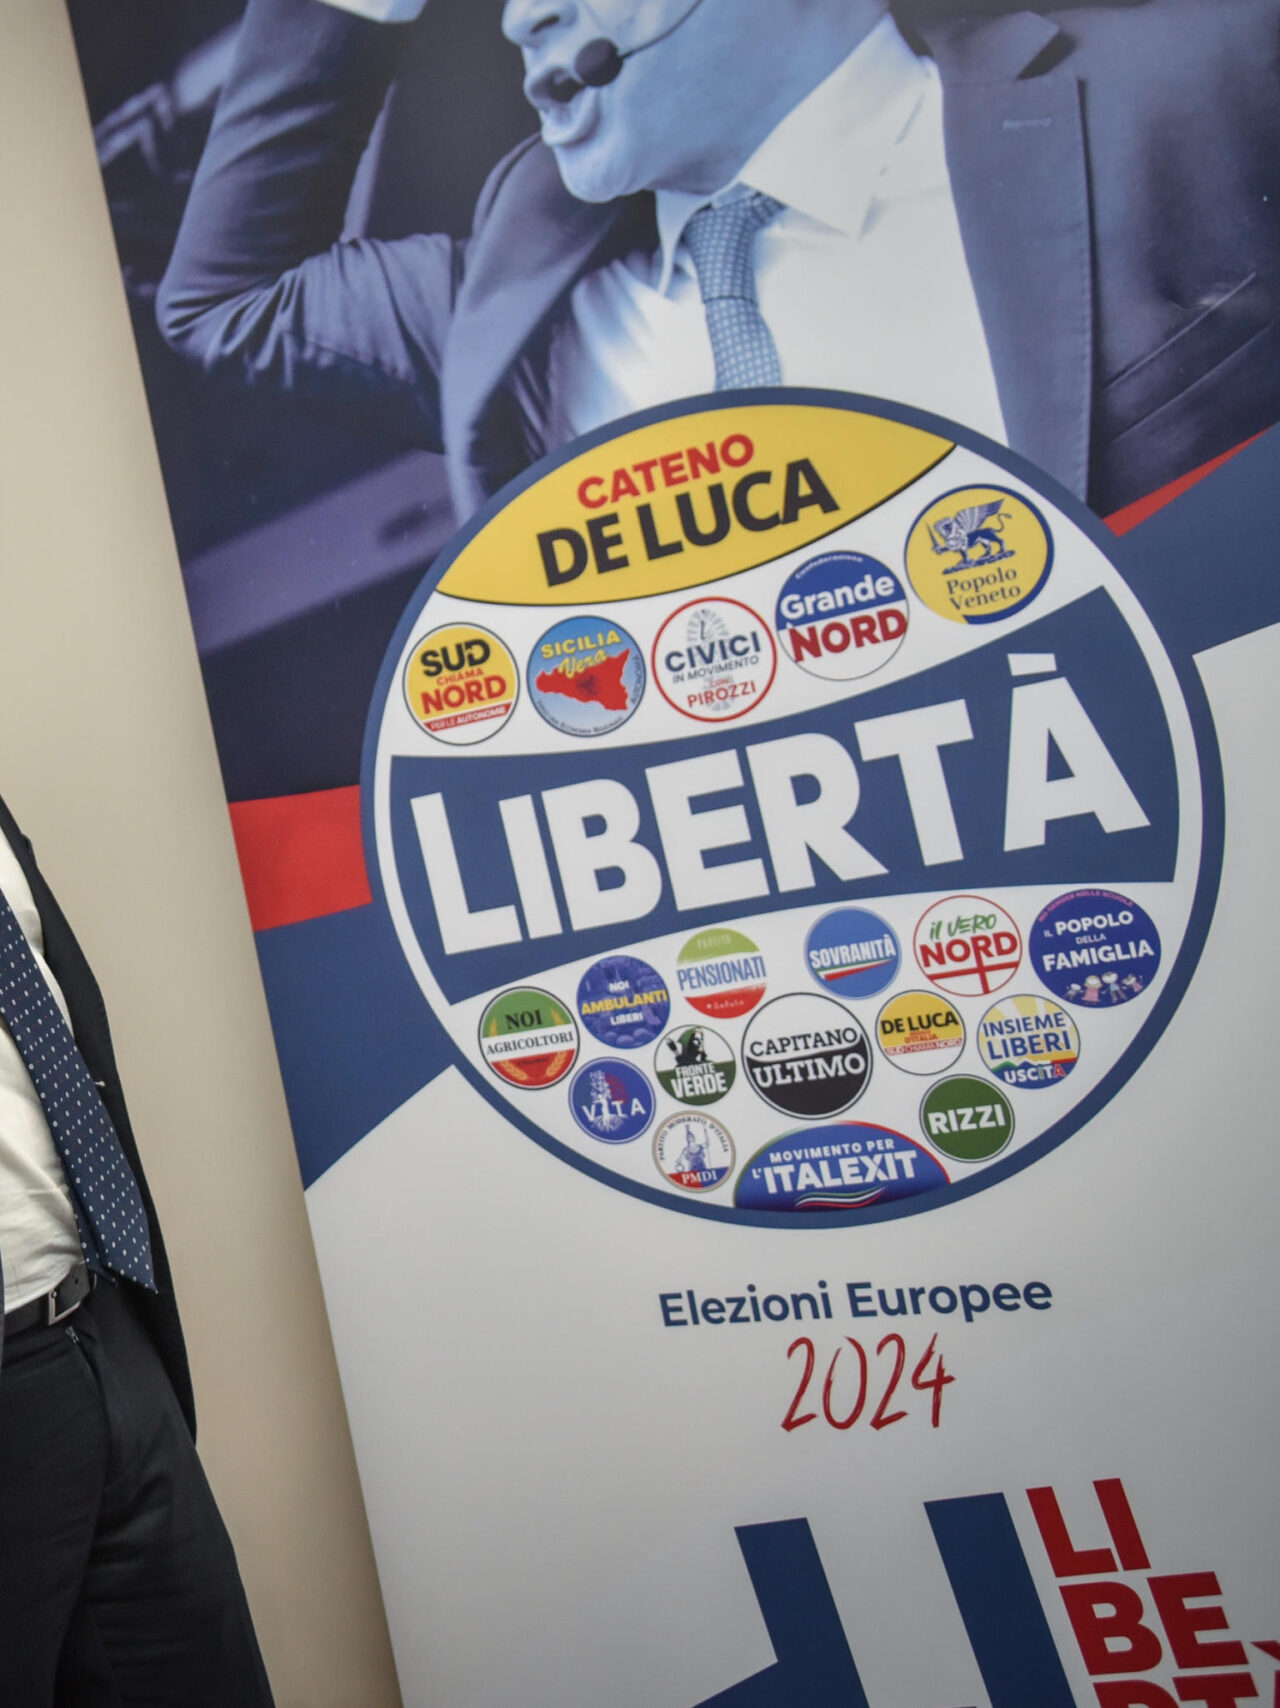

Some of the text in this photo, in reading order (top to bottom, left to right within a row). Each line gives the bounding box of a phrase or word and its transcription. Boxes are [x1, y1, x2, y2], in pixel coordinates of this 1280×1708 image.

[577, 433, 755, 509] CATENO
[536, 458, 840, 587] DE LUCA
[946, 567, 1017, 595] Popolo
[780, 574, 895, 620] Grande
[949, 585, 1022, 611] Veneto
[541, 629, 622, 660] SICILIA
[789, 608, 907, 663] NORD
[420, 638, 491, 678] SUD
[558, 648, 608, 678] Vera
[665, 631, 761, 672] CIVICI
[436, 667, 484, 687] CHIAMA
[672, 655, 759, 684] IN MOVIMENTO
[420, 674, 507, 715] NORD
[687, 680, 756, 708] PIROZZI
[410, 652, 1151, 954] LIBERTÀ
[1043, 910, 1134, 938] IL POPOLO
[1075, 933, 1107, 945] DELLA
[809, 934, 897, 969] SOVRANITÀ
[919, 931, 1018, 968] NORD
[1042, 939, 1155, 972] FAMIGLIA
[609, 980, 629, 993] NOI
[677, 955, 767, 991] PENSIONATI
[581, 989, 668, 1015] AMBULANTI
[505, 1009, 543, 1030] NOI
[610, 1012, 644, 1026] LIBERI
[880, 1011, 959, 1034] DE LUCA
[983, 1012, 1066, 1037] INSIEME
[486, 1031, 574, 1054] AGRICOLTORI
[749, 1027, 858, 1057] CAPITANO
[986, 1029, 1071, 1061] LIBERI
[675, 1062, 716, 1077] FRONTE
[752, 1052, 865, 1088] ULTIMO
[1003, 1064, 1066, 1085] USCITA
[670, 1072, 728, 1099] VERDE
[927, 1103, 1005, 1135] RIZZI
[769, 1138, 895, 1164] MOVIMENTO PER
[681, 1170, 718, 1185] PMDI
[659, 1280, 1053, 1327] Elezioni Europee
[781, 1332, 956, 1432] 2024
[1026, 1477, 1151, 1578] LI
[1059, 1571, 1249, 1676] BE
